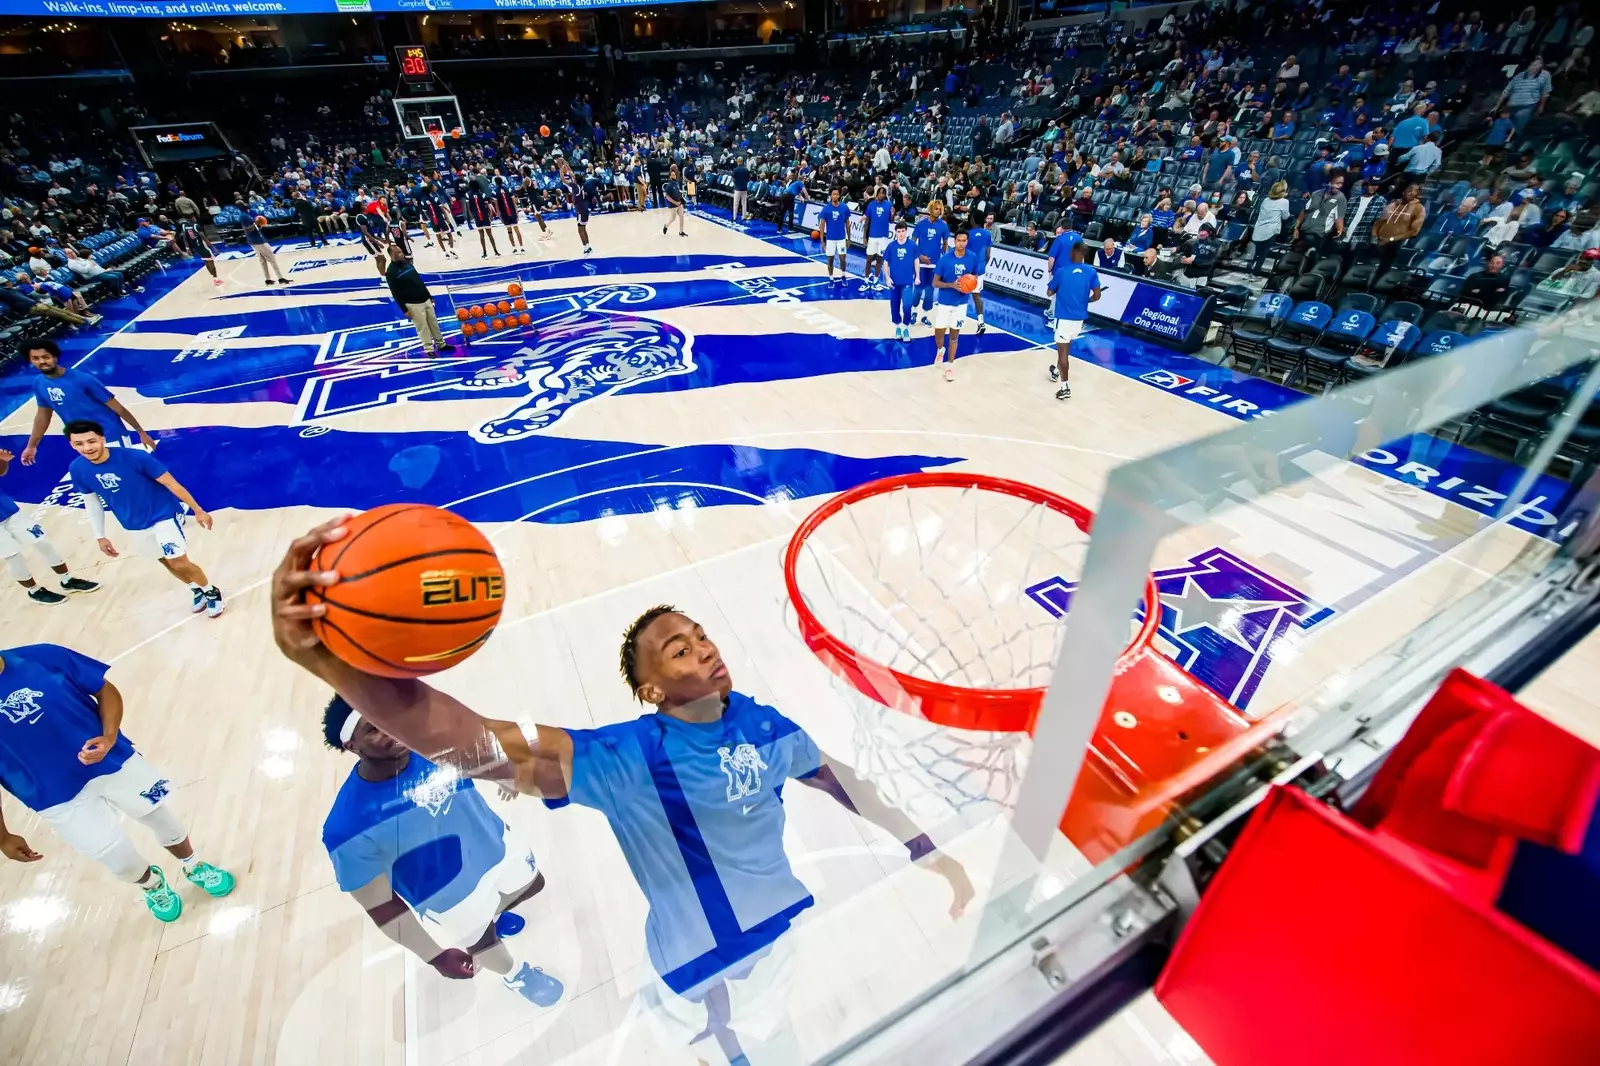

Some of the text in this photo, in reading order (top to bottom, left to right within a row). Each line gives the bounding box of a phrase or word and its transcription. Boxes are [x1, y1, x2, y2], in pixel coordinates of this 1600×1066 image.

[43, 1, 287, 15] Walk-ins, limp-ins, and roll-ins welcome.
[995, 275, 1014, 286] IDEAS
[1016, 280, 1037, 292] MOVE
[1133, 316, 1178, 336] One Health
[1141, 307, 1180, 326] Regional
[421, 576, 503, 608] ELITE
